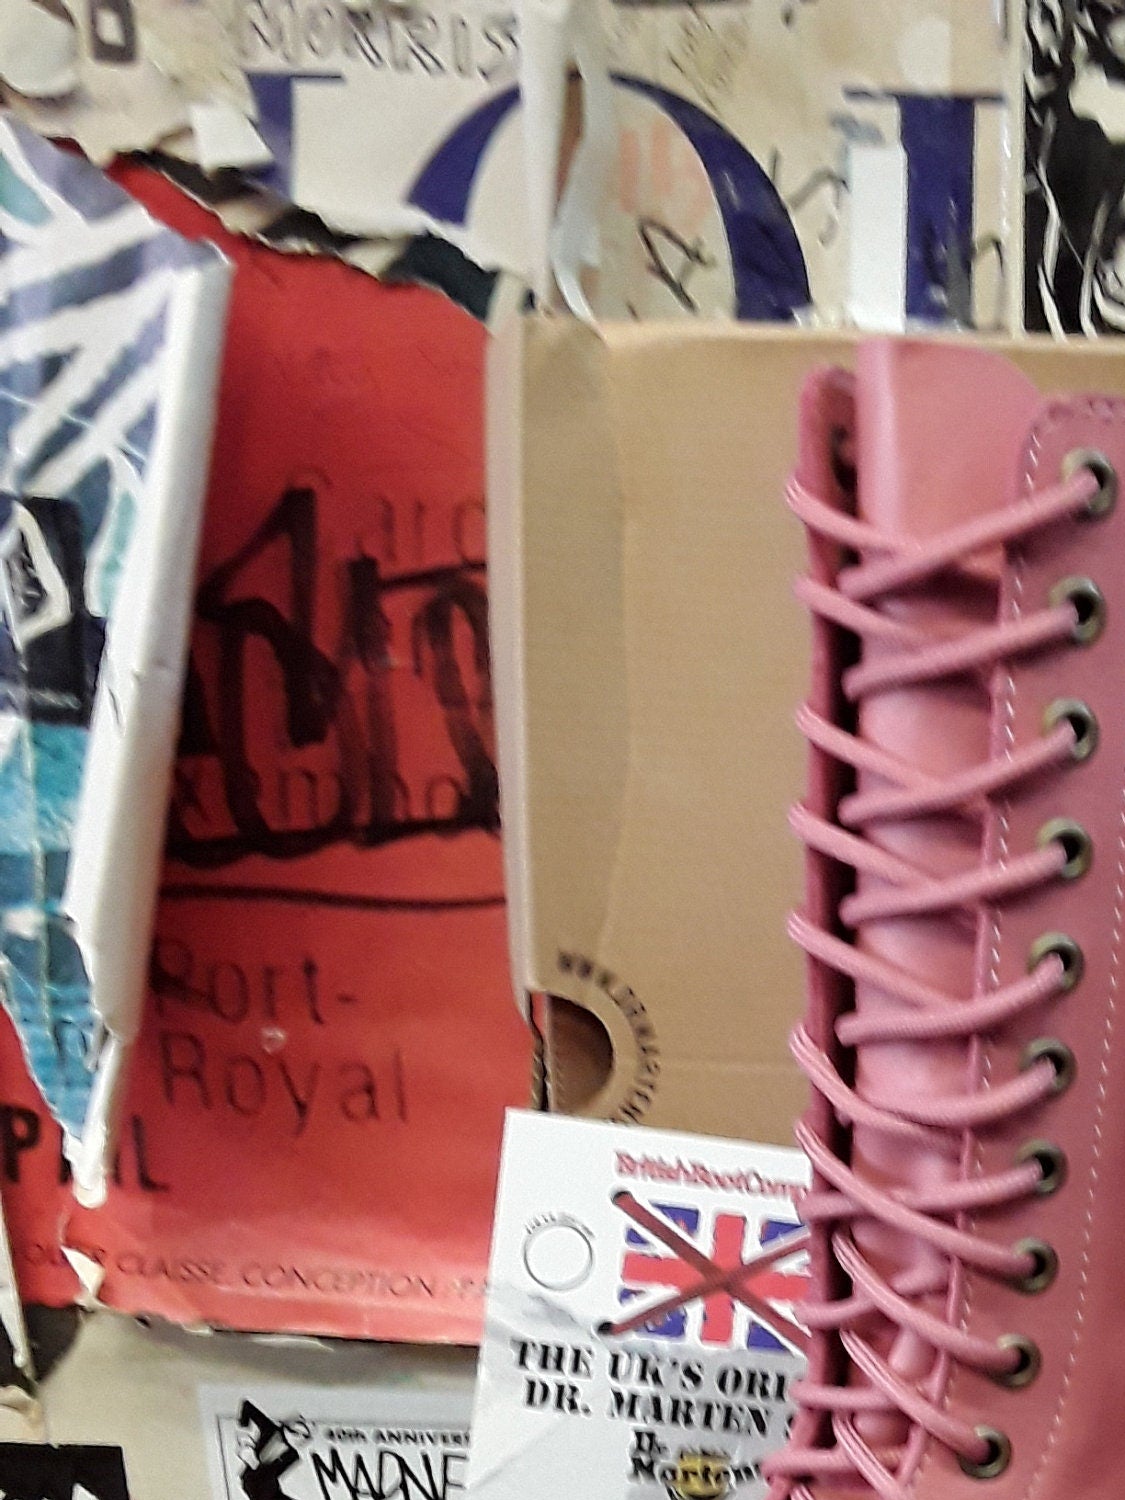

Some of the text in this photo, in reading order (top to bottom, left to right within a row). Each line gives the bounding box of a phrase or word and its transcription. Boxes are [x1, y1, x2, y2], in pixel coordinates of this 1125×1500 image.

[162, 1031, 409, 1136] Royal
[242, 1262, 435, 1297] CONCEPTION
[509, 1338, 595, 1381] THE
[606, 1348, 702, 1390] UK'S
[523, 1378, 592, 1416] DR.
[607, 1387, 770, 1437] MARTEN
